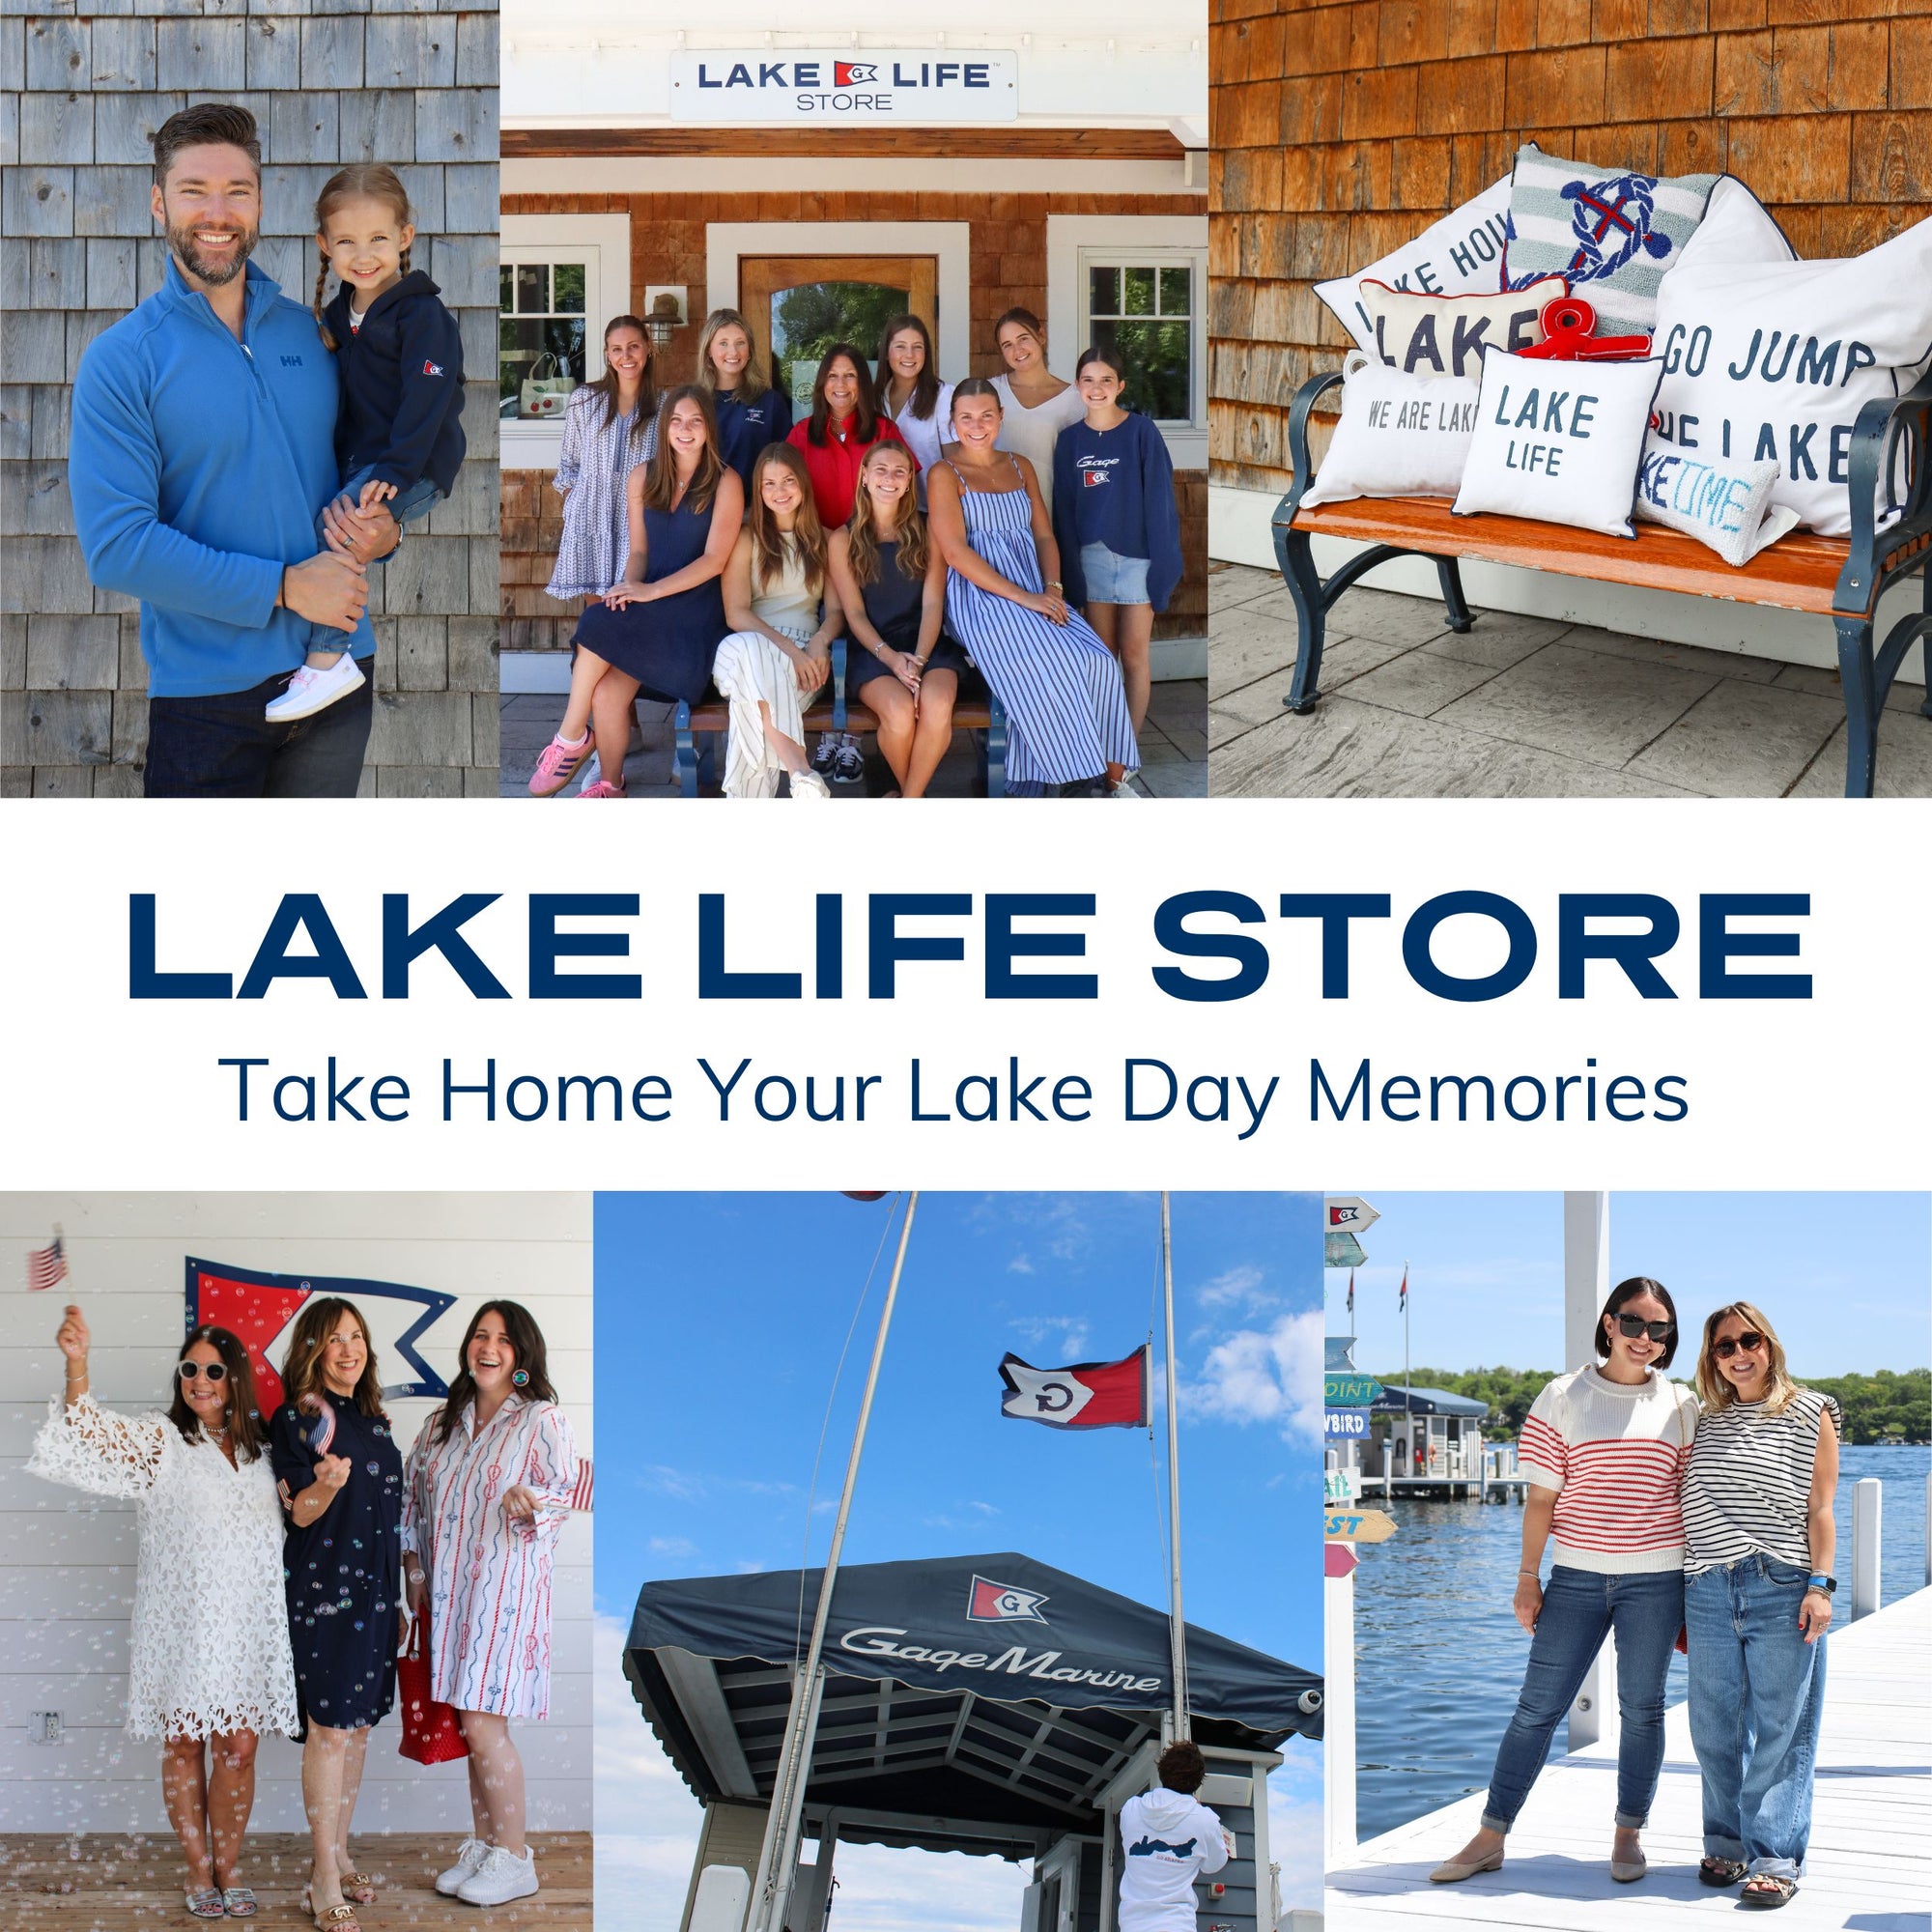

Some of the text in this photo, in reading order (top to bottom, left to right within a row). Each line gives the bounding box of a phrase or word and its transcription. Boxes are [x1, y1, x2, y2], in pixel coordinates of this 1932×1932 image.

[699, 63, 820, 88] LAKE
[894, 63, 989, 88] LIFE
[796, 94, 894, 111] STORE
[1377, 314, 1538, 376] LAKE
[1665, 324, 1876, 387] GO JUMP
[280, 355, 302, 367] HH
[1369, 400, 1479, 433] WE ARE LAK
[1495, 384, 1599, 439] LAKE
[1077, 455, 1121, 469] Gage
[1506, 440, 1564, 476] LIFE
[1324, 1515, 1364, 1536] ST
